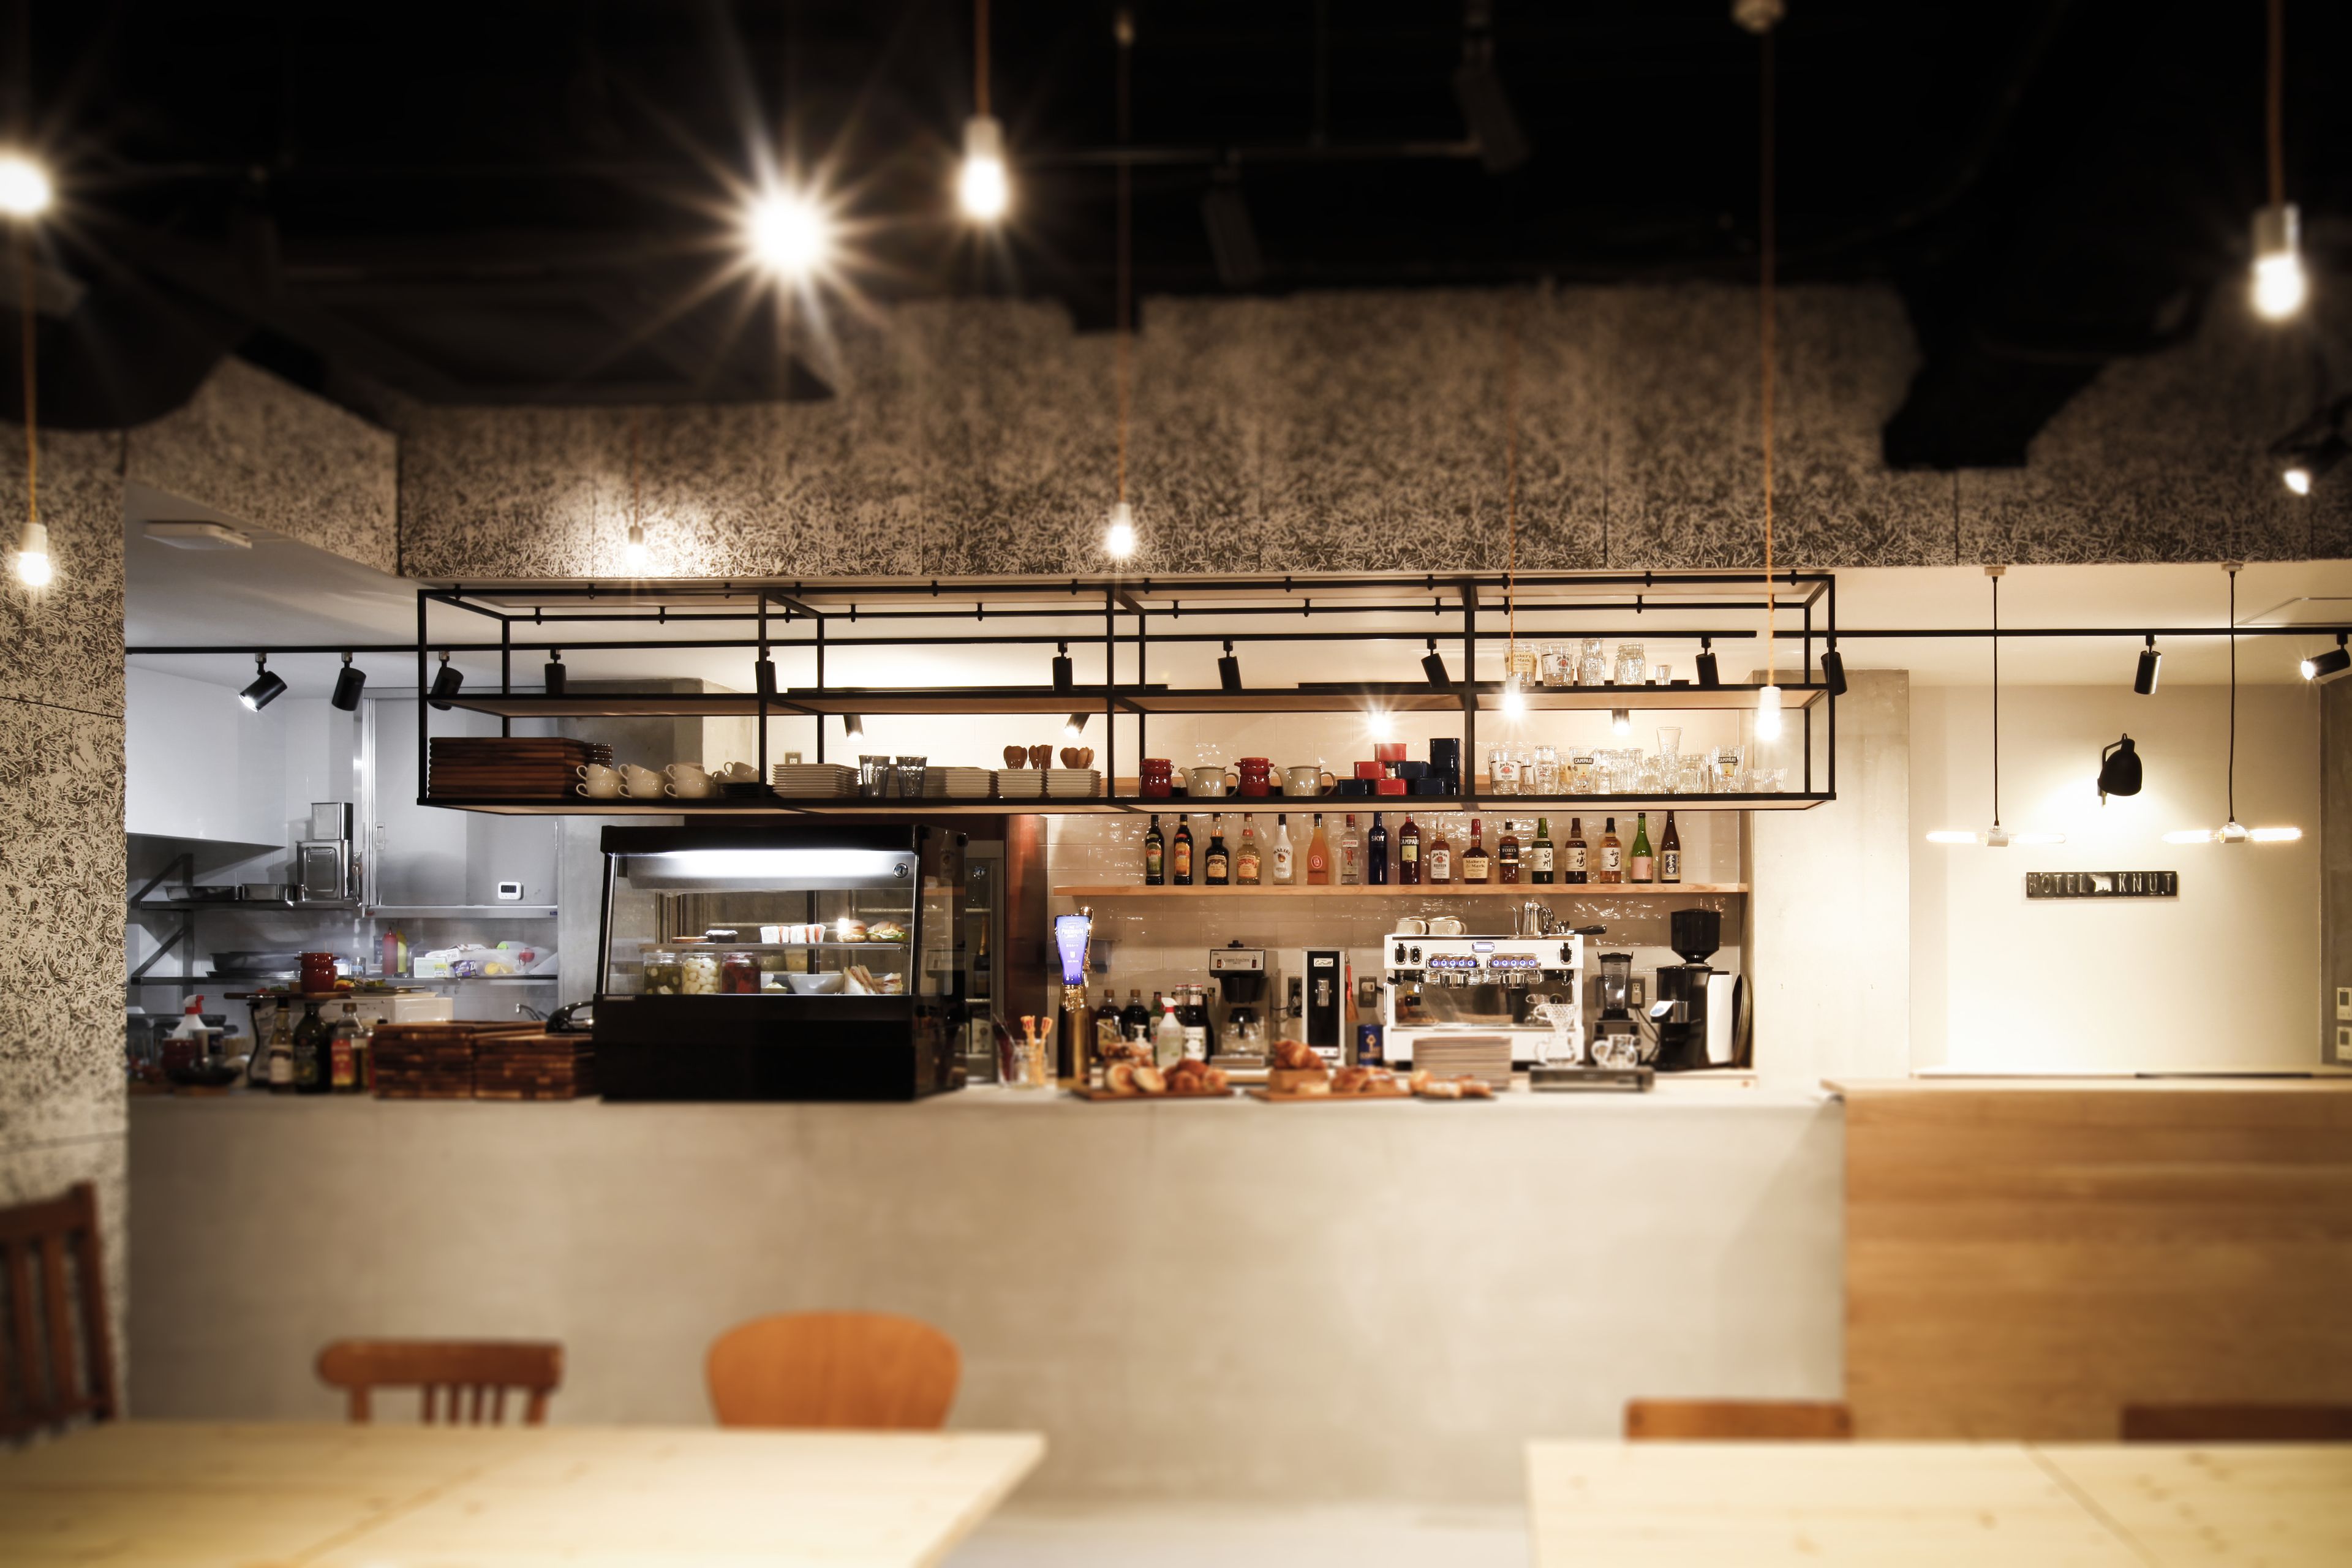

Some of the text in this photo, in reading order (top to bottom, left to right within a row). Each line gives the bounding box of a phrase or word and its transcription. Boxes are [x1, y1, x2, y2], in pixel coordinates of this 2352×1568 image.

[1543, 850, 1551, 868] 白州
[2029, 873, 2172, 893] HOTEL KNUT
